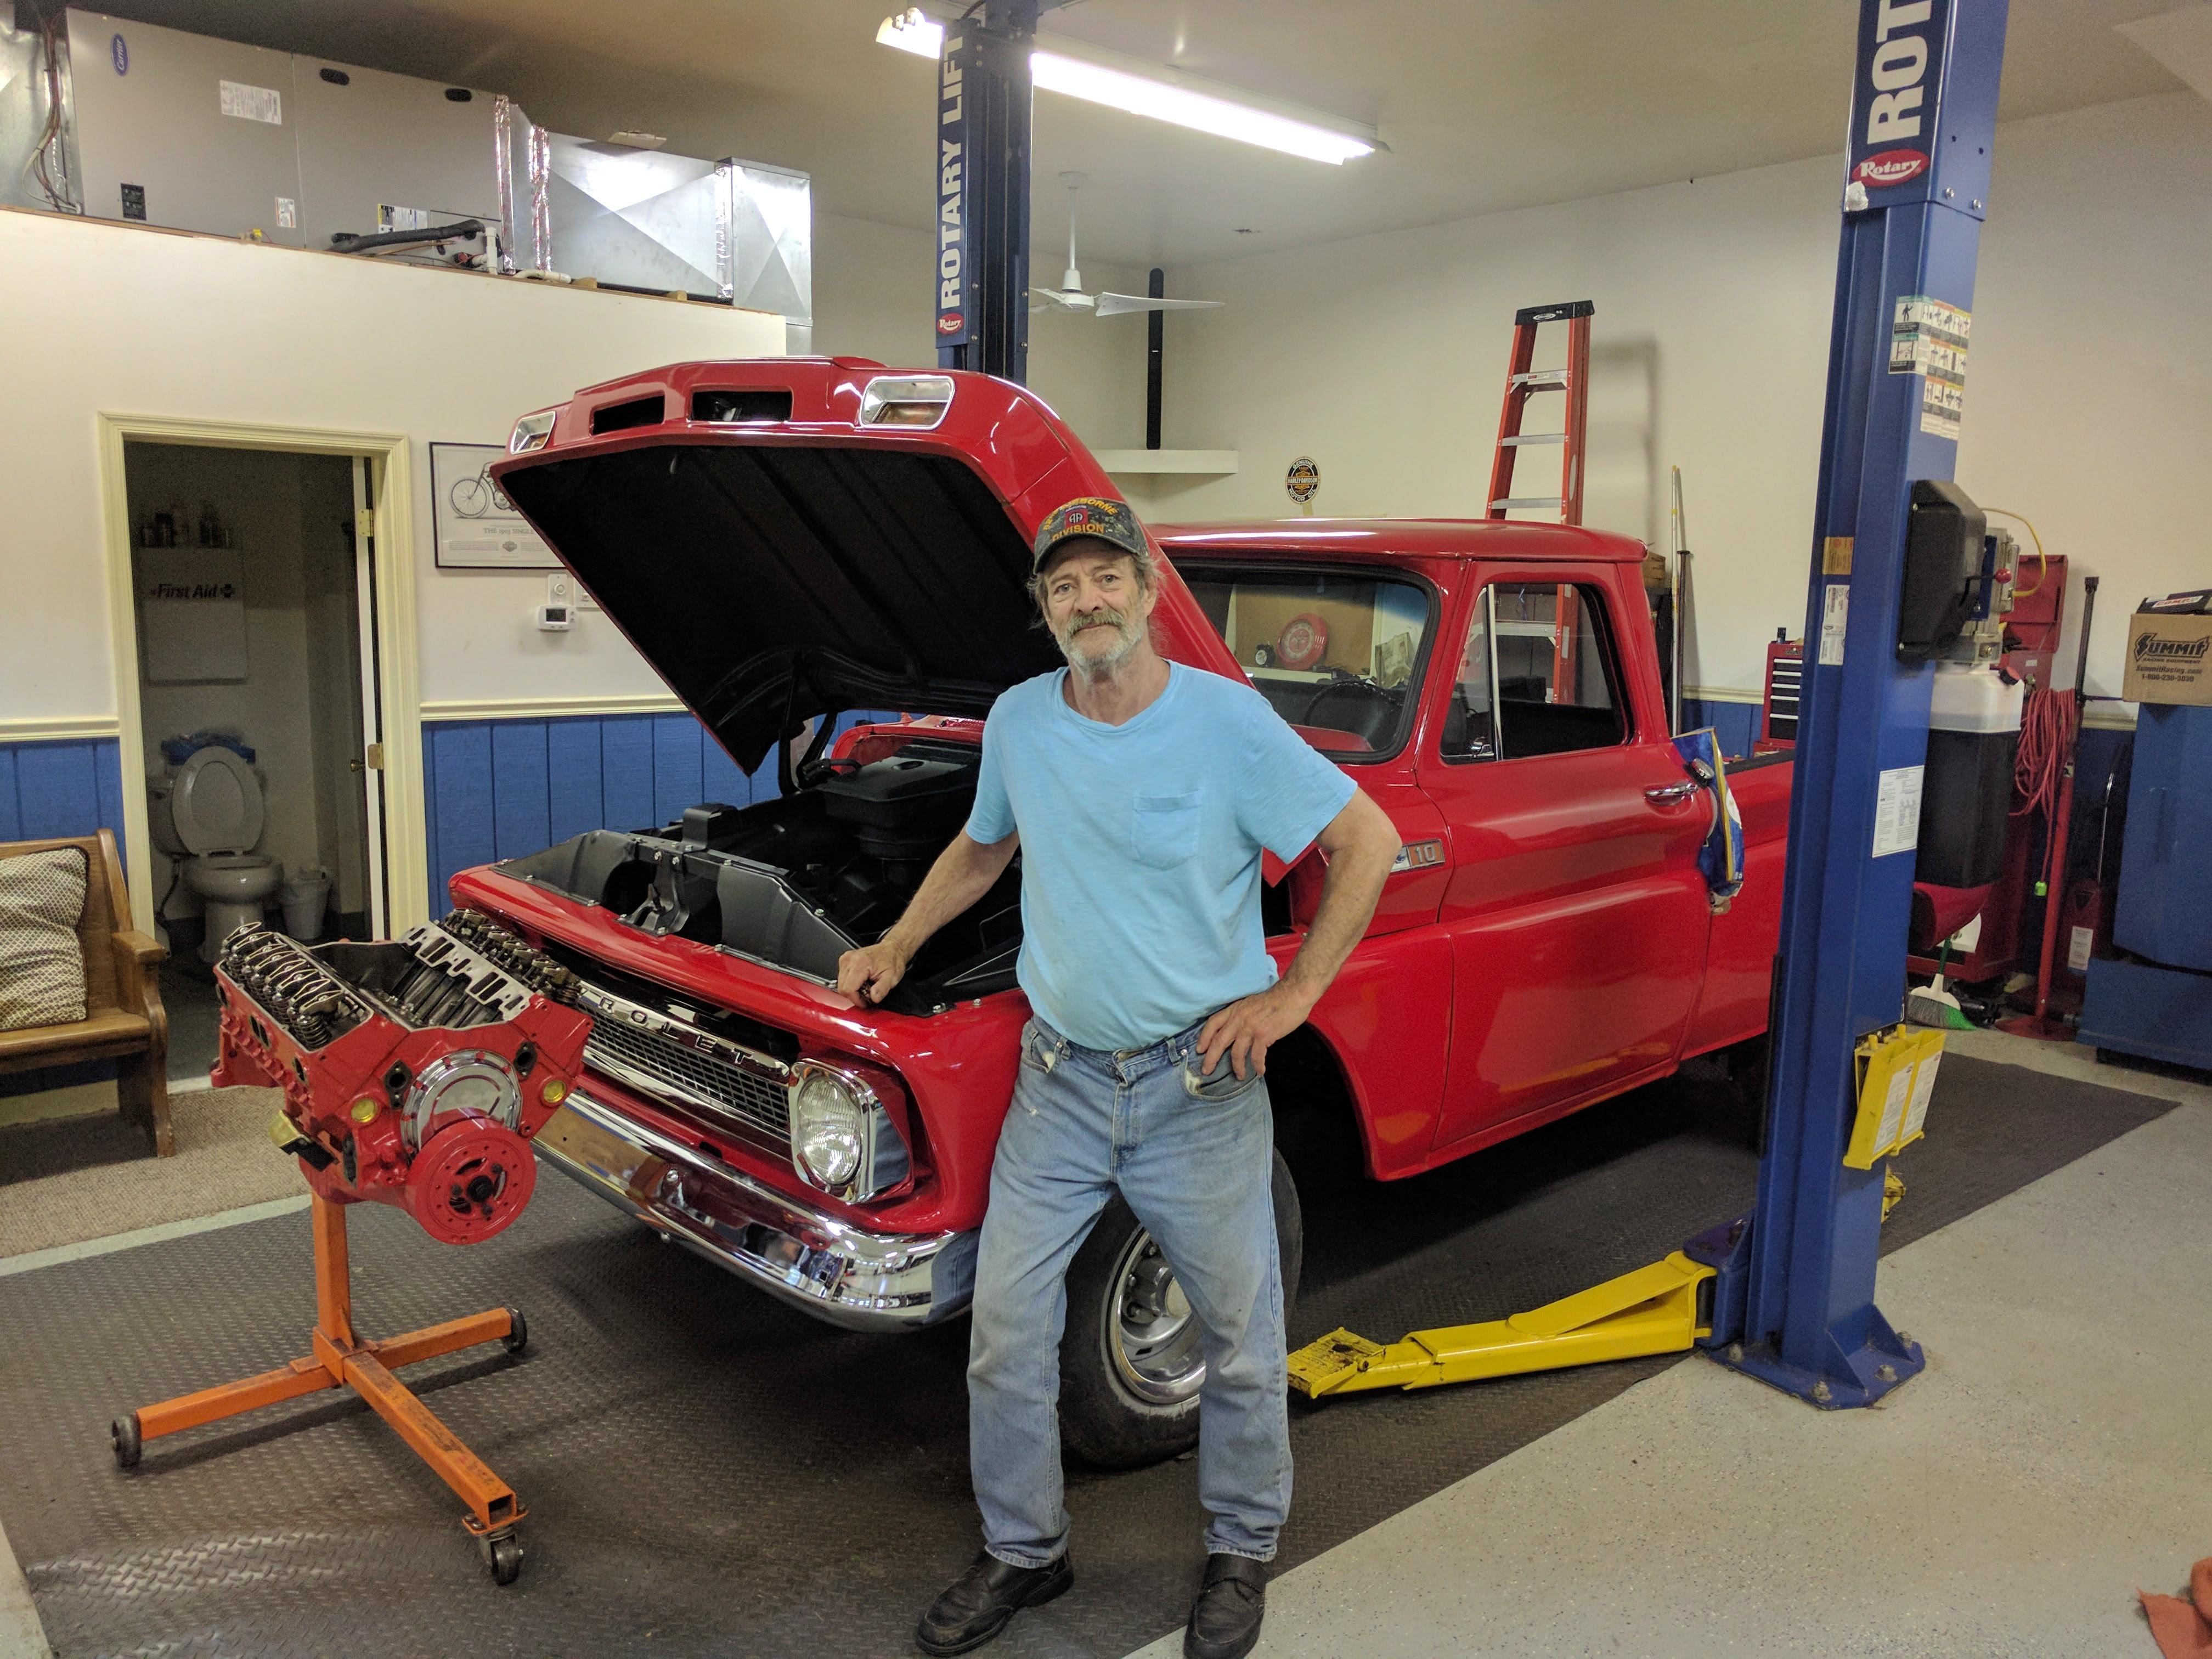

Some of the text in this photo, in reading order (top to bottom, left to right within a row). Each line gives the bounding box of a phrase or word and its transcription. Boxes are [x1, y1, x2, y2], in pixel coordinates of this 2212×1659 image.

[116, 38, 125, 71] Carrier
[941, 35, 963, 309] ROTARY LIFT
[1860, 159, 1921, 180] Rotary
[939, 319, 962, 331] Rotary
[1293, 459, 1314, 469] GENUINE
[1288, 488, 1306, 501] MOTOR
[1307, 488, 1317, 498] OIL
[1062, 498, 1119, 515] BORNE
[1052, 523, 1104, 541] DIVISION
[157, 583, 190, 599] First
[192, 584, 218, 598] Aid
[2135, 634, 2208, 659] SUMMIT
[1416, 844, 1436, 864] 10
[582, 989, 753, 1065] ROLET
